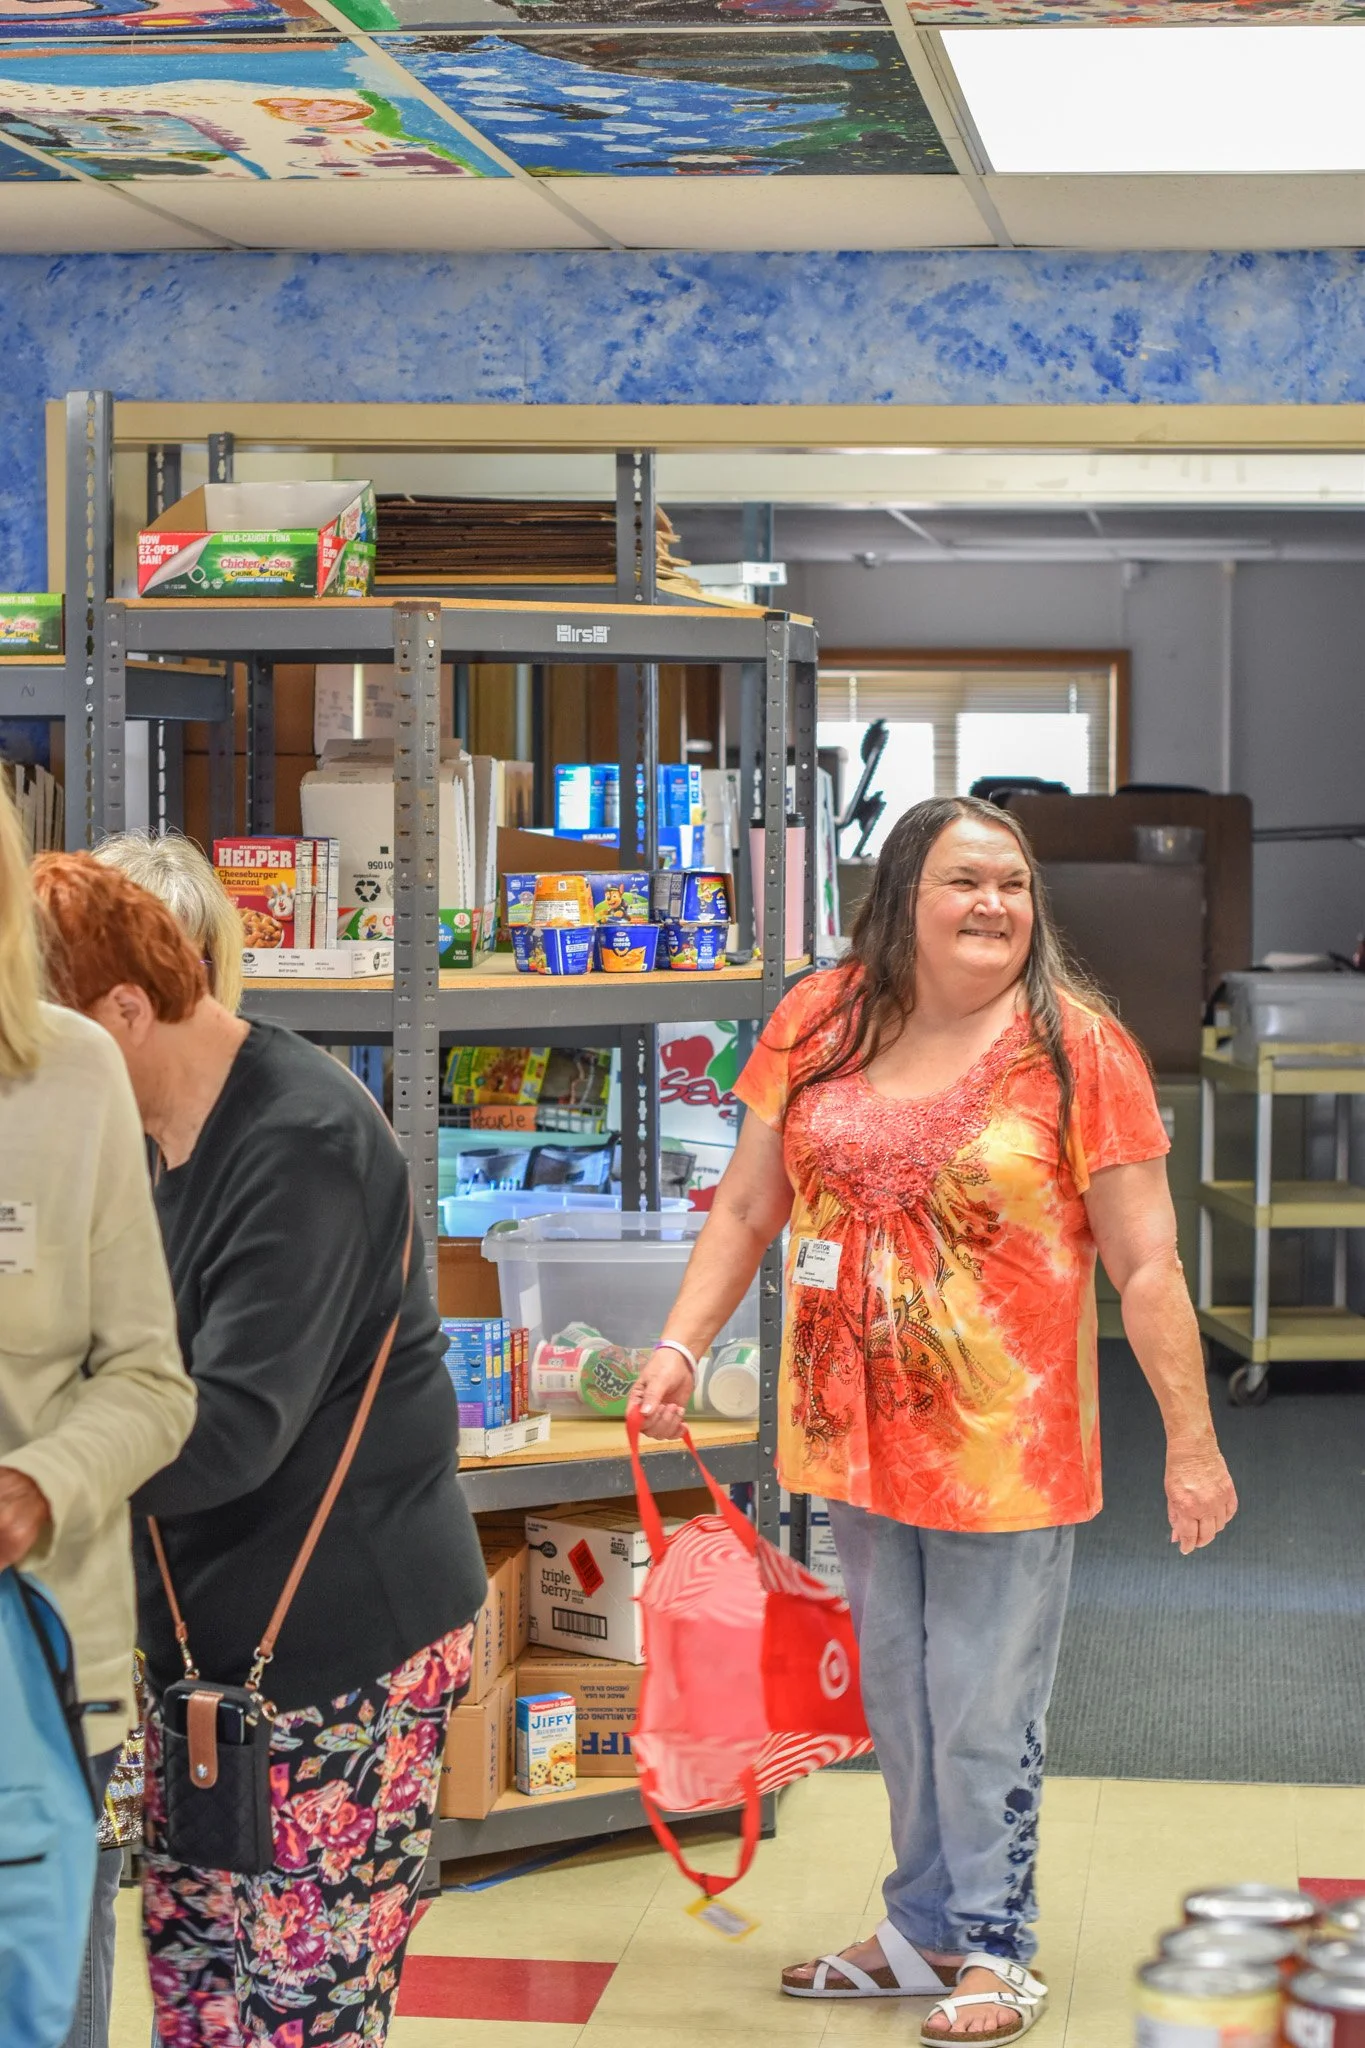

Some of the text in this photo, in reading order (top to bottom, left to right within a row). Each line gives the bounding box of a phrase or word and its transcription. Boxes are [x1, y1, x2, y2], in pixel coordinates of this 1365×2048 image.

[139, 535, 160, 544] NOW
[223, 533, 291, 543] WILD-CAUGHT TUNA
[139, 545, 179, 555] EZ-OPEN
[139, 555, 162, 565] CAN!
[220, 558, 292, 569] Chicken Sea
[218, 848, 293, 868] HELPER
[218, 870, 278, 880] Cheeseburger
[221, 878, 260, 886] Macaroni
[472, 1109, 526, 1129] Recycle
[541, 1568, 571, 1585] triple
[540, 1580, 572, 1602] berry
[531, 1714, 573, 1729] JIFFY
